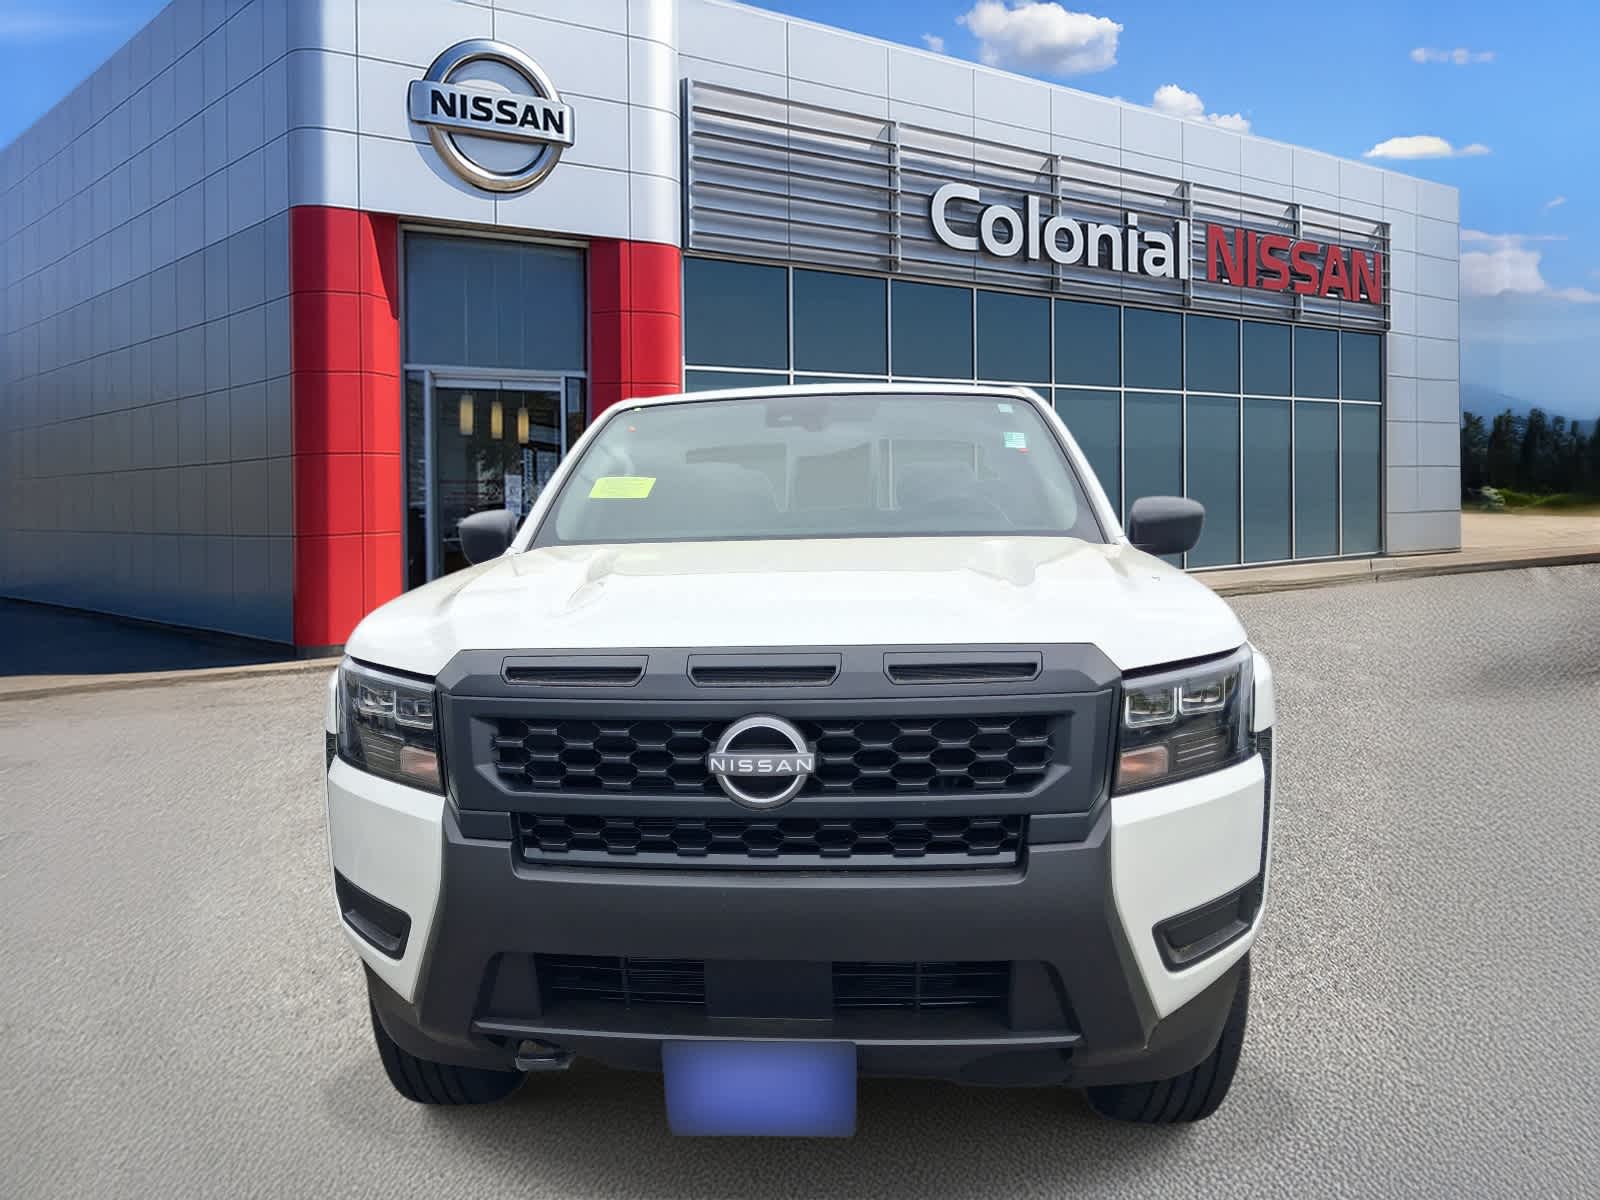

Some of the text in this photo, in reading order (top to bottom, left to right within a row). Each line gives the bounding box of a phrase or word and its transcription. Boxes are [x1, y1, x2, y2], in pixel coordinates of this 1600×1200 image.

[430, 89, 564, 134] NISSAN
[930, 183, 1382, 304] Colonial NISSAN
[710, 758, 812, 773] NISSAN
